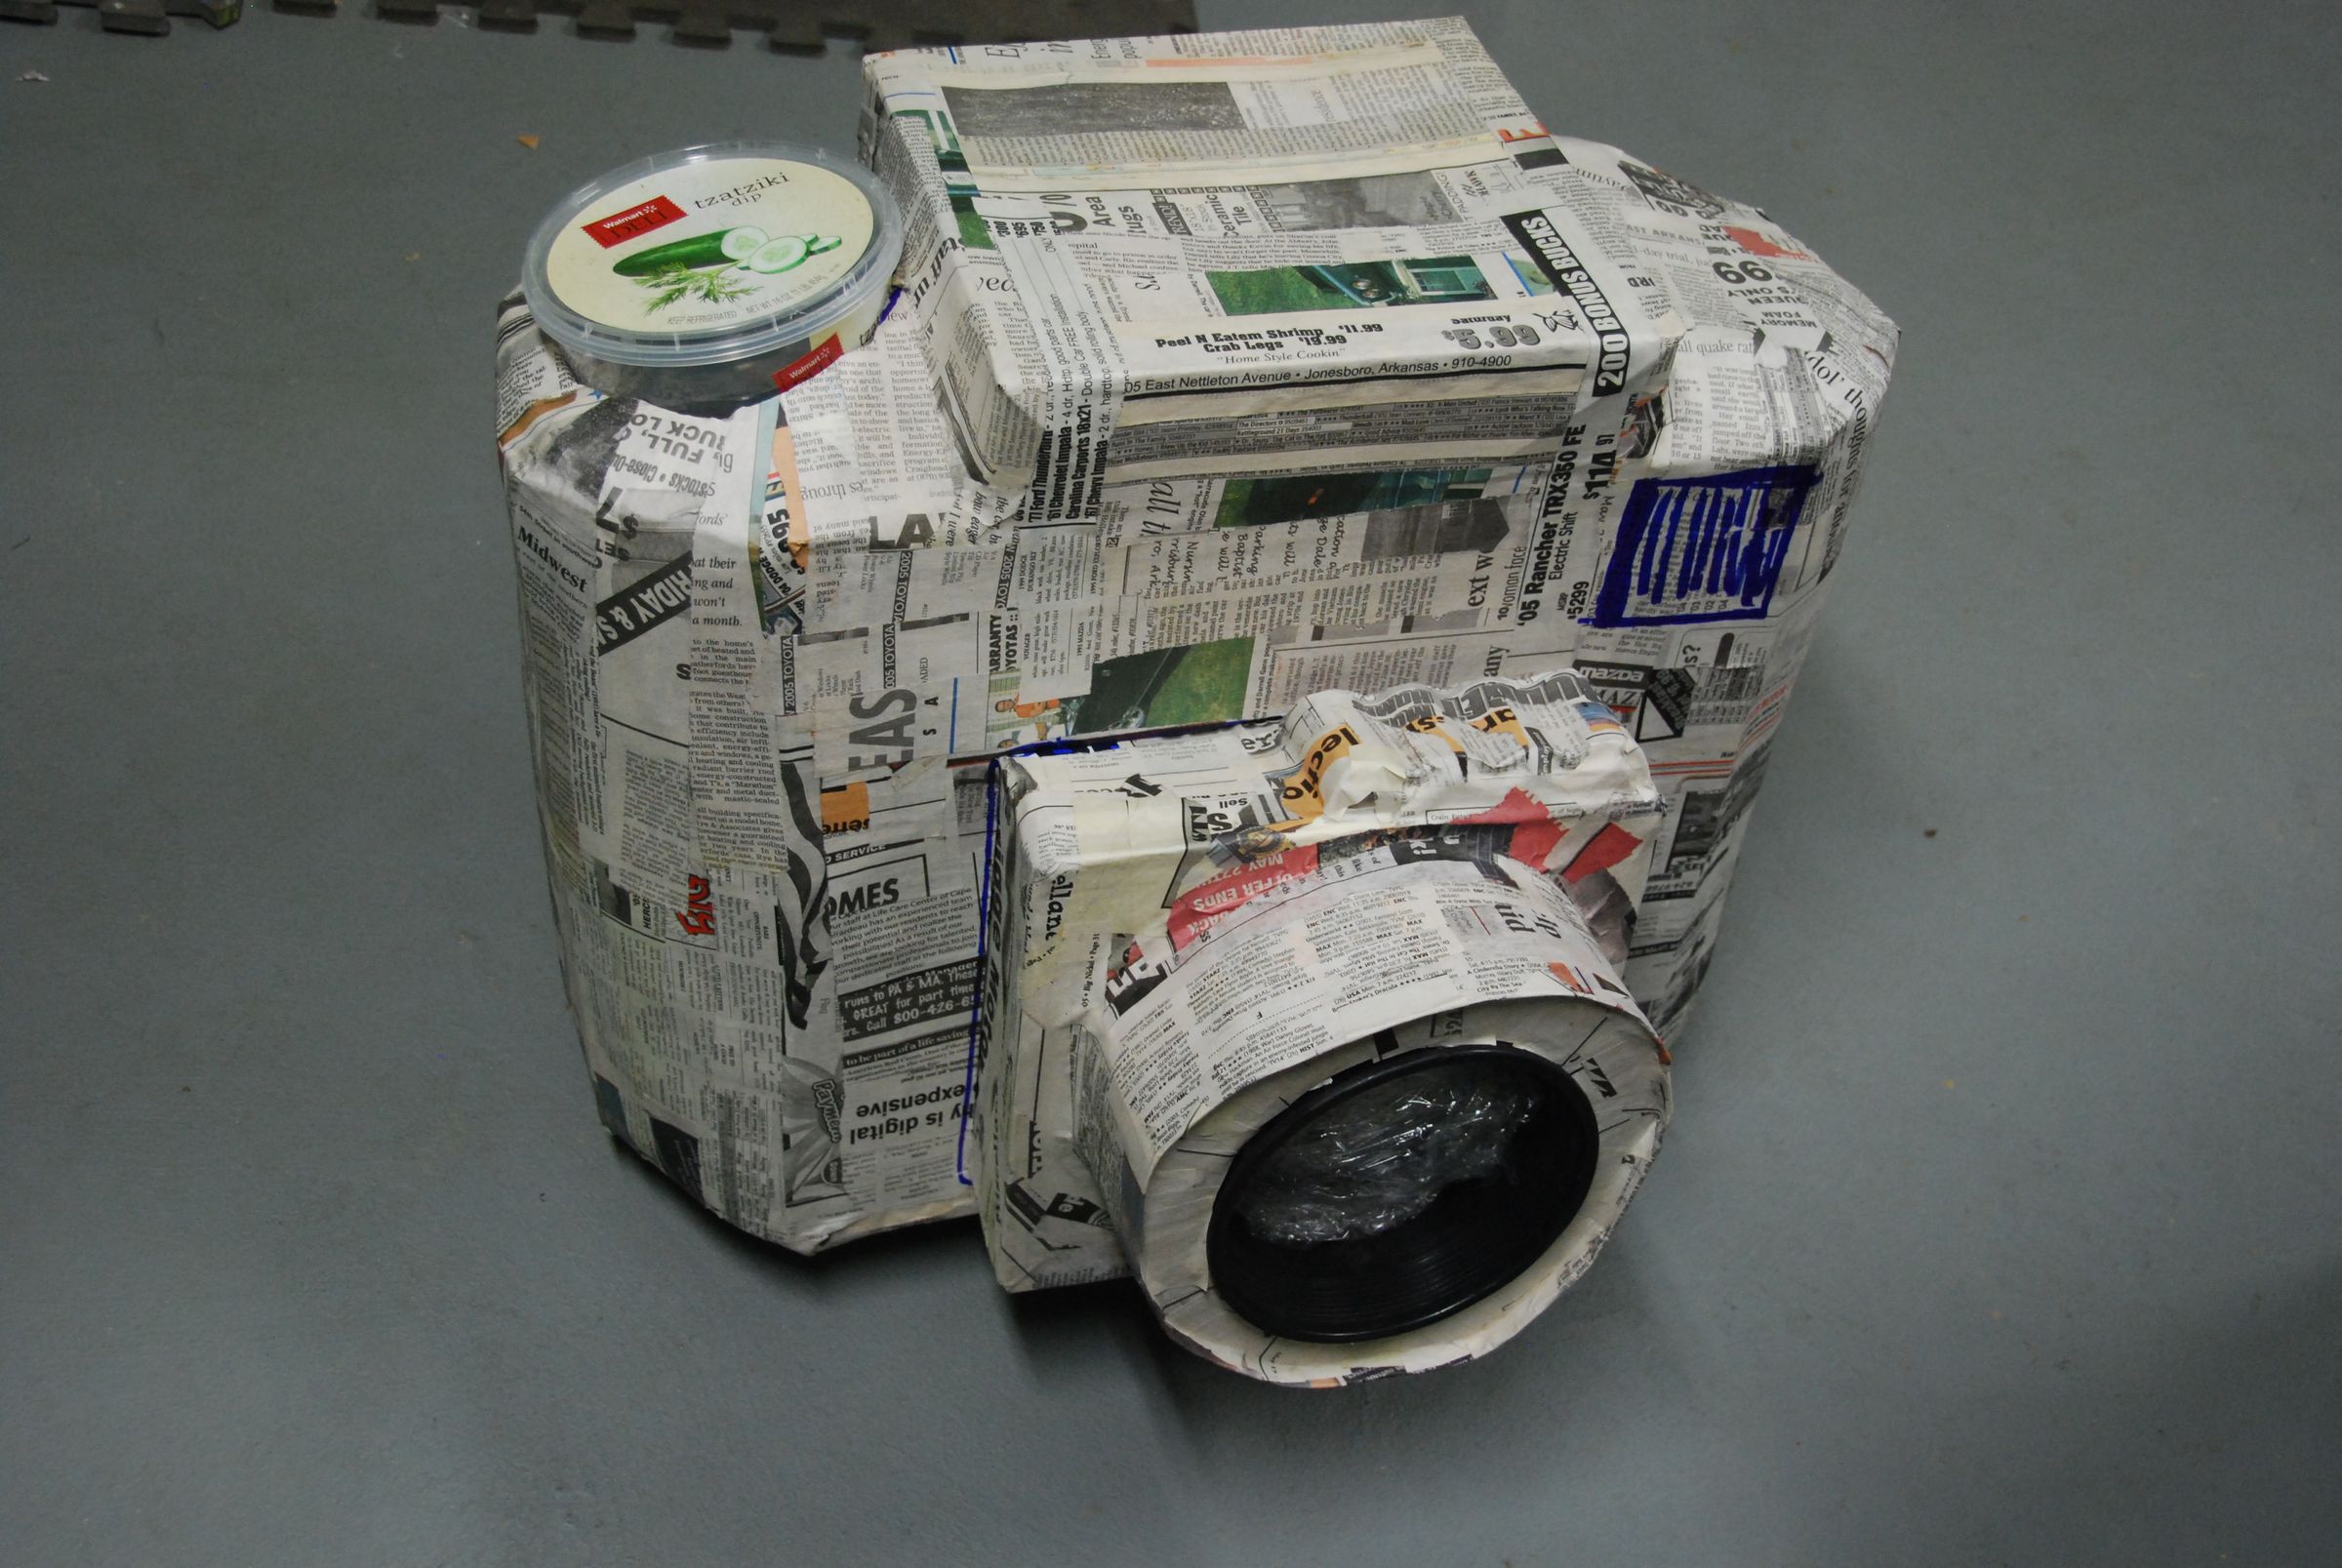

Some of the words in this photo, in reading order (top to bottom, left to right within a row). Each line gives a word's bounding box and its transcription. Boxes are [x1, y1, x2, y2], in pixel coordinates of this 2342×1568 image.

[695, 173, 789, 210] tzatziki
[732, 193, 762, 208] dip
[603, 210, 645, 231] Walmart
[1086, 196, 1114, 227] Area
[1232, 206, 1251, 225] Tile
[1522, 218, 1573, 272] BUCKS
[1713, 261, 1773, 284] 99
[1563, 272, 1614, 331] BONUS
[1727, 287, 1772, 297] ONLY
[686, 311, 738, 323] REFRIGERATED
[1077, 311, 1090, 326] body
[1760, 318, 1817, 328] MEMORY
[1047, 330, 1063, 346] parts
[1063, 327, 1077, 347] FREE
[1085, 327, 1099, 348] rolling
[1155, 337, 1191, 348] Peel
[1212, 331, 1263, 343] Eatem
[1266, 327, 1323, 342] Shrimp
[1204, 342, 1242, 353] Crab
[1245, 340, 1284, 352] Legs
[1054, 347, 1070, 365] good
[1073, 348, 1085, 362] Car
[1093, 347, 1107, 365] solid
[1265, 352, 1295, 361] Style
[1695, 342, 1734, 357] quake
[789, 354, 821, 379] Walmart
[1597, 335, 1626, 387] 200
[1079, 363, 1093, 396] Double
[1146, 379, 1175, 392] East
[1179, 376, 1238, 388] Nettleton
[1241, 373, 1291, 384] Avenue
[1304, 363, 1375, 382] Jonesboro,
[1378, 360, 1438, 375] Arkansas
[1452, 354, 1512, 370] 910-4900
[1099, 368, 1112, 406] hardtop,
[1077, 404, 1091, 435] 18x21
[1339, 412, 1374, 422] Thunderball
[1563, 423, 1587, 447] FE
[1057, 426, 1072, 468] Impala
[1073, 435, 1089, 477] Carports
[1030, 483, 1045, 504] Ford
[1050, 468, 1066, 510] Chevrolet
[1543, 451, 1579, 519] TRX350
[1066, 477, 1082, 519] Carolina
[1146, 483, 1180, 512] all
[1232, 534, 1248, 579] Baptist
[1283, 543, 1296, 567] will
[1313, 537, 1327, 568] Dale
[1548, 543, 1571, 582] Electric
[1560, 511, 1578, 543] Shift
[518, 525, 588, 593] Midwest
[709, 556, 738, 570] their
[761, 554, 782, 583] DODGE
[899, 551, 913, 585] 2005
[999, 554, 1015, 583] 2005
[1217, 547, 1230, 572] will
[1524, 522, 1559, 594] Rancher
[710, 578, 734, 589] and
[694, 597, 726, 608] won't
[893, 586, 909, 624] TOYOTA
[1517, 599, 1540, 625] '05
[1557, 592, 1569, 612] MSRP
[609, 609, 634, 630] &
[705, 616, 743, 626] month.
[884, 624, 896, 664] TOYOTA
[782, 636, 794, 681] TOYOTA
[1483, 645, 1511, 677] any
[1581, 665, 1645, 683] mazda
[785, 681, 796, 708] 2005
[923, 696, 939, 706] A
[1248, 855, 1284, 871] MAY
[898, 903, 949, 917] experienced
[950, 896, 972, 905] team
[910, 898, 937, 907] Center
[949, 887, 972, 897] Cape
[1192, 887, 1237, 909] ENDS
[900, 911, 939, 926] residents
[949, 904, 974, 912] reach
[841, 942, 862, 951] their
[864, 930, 901, 945] potential
[919, 917, 947, 928] realize
[843, 940, 894, 959] possibilities!
[914, 928, 937, 938] result
[1305, 927, 1341, 943] Underworld
[939, 942, 978, 955] following
[1086, 960, 1095, 978] Nickel
[1203, 968, 1220, 983] STARZ
[1474, 965, 1503, 974] Cinderella
[845, 995, 870, 1009] runs
[873, 992, 884, 1001] to
[888, 985, 902, 996] PA
[919, 977, 945, 989] MA.
[1347, 990, 1360, 999] USA
[1374, 984, 1397, 995] Dracula
[853, 1002, 889, 1021] GREAT
[896, 997, 911, 1009] for
[919, 989, 943, 1005] part
[950, 984, 975, 996] time
[867, 1018, 887, 1031] Call
[873, 1049, 896, 1059] part
[918, 1037, 935, 1047] life
[1300, 1043, 1314, 1054] HIST
[857, 1085, 966, 1117] expensive
[927, 1110, 944, 1126] is
[851, 1116, 917, 1145] digital
